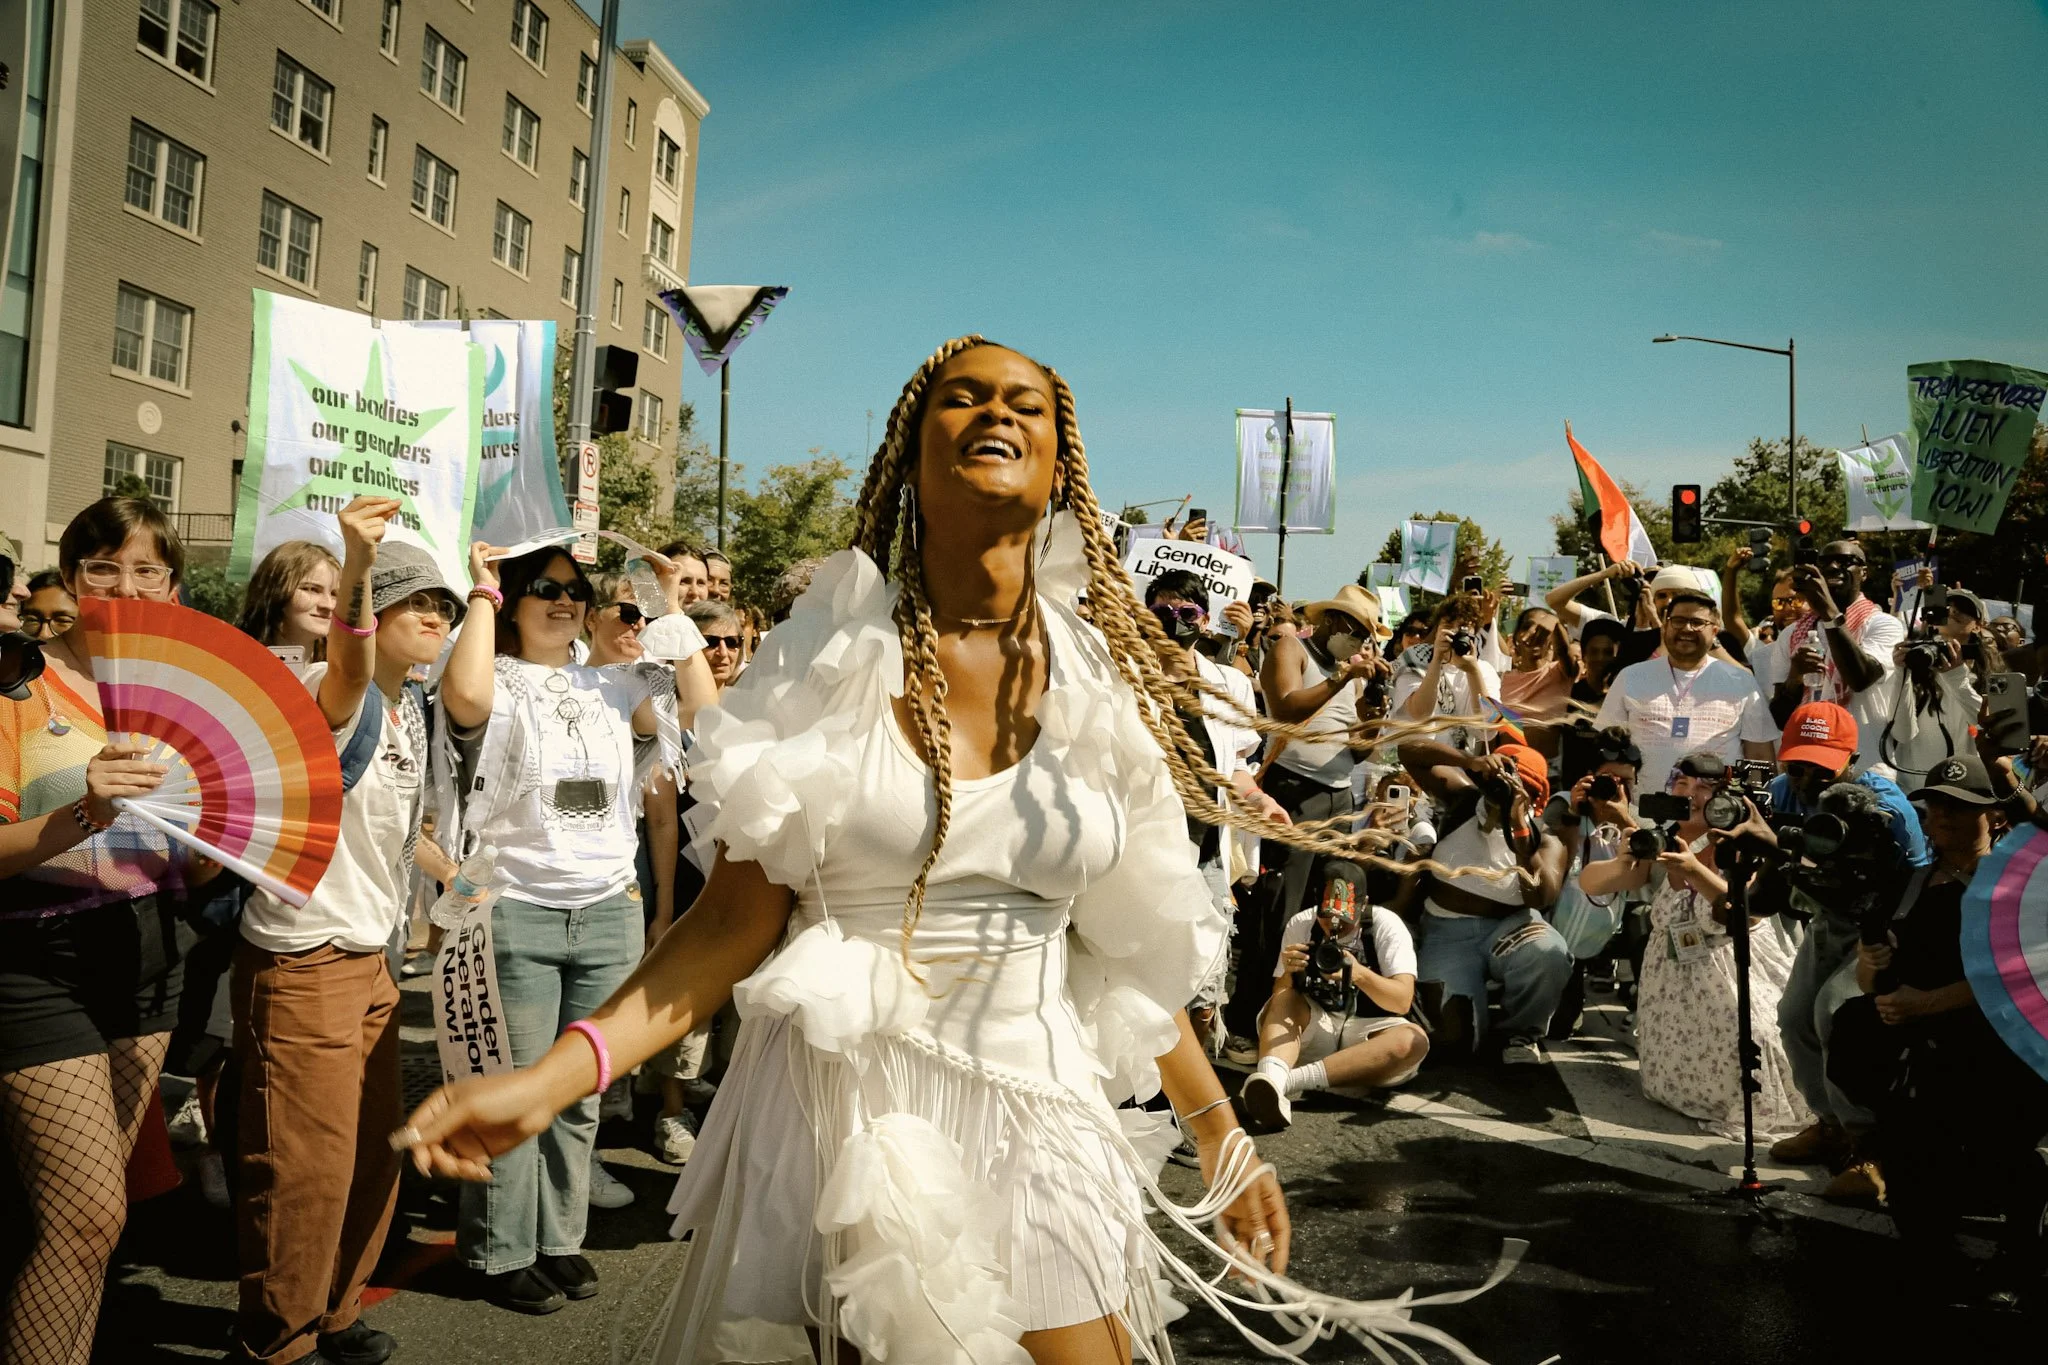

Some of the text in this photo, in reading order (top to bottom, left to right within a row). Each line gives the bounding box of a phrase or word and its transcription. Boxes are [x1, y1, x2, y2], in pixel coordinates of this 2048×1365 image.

[312, 387, 419, 428] our bodies
[1924, 402, 2010, 447] ALIEN
[312, 421, 431, 464] our genders
[309, 456, 420, 496] our choices
[306, 493, 345, 515] our
[1134, 559, 1239, 600] Libtion
[1154, 545, 1233, 576] Gender
[1800, 731, 1829, 740] MATTERS
[1805, 717, 1827, 725] BLACK
[443, 946, 465, 1043] Now!
[471, 921, 502, 1065] Gender
